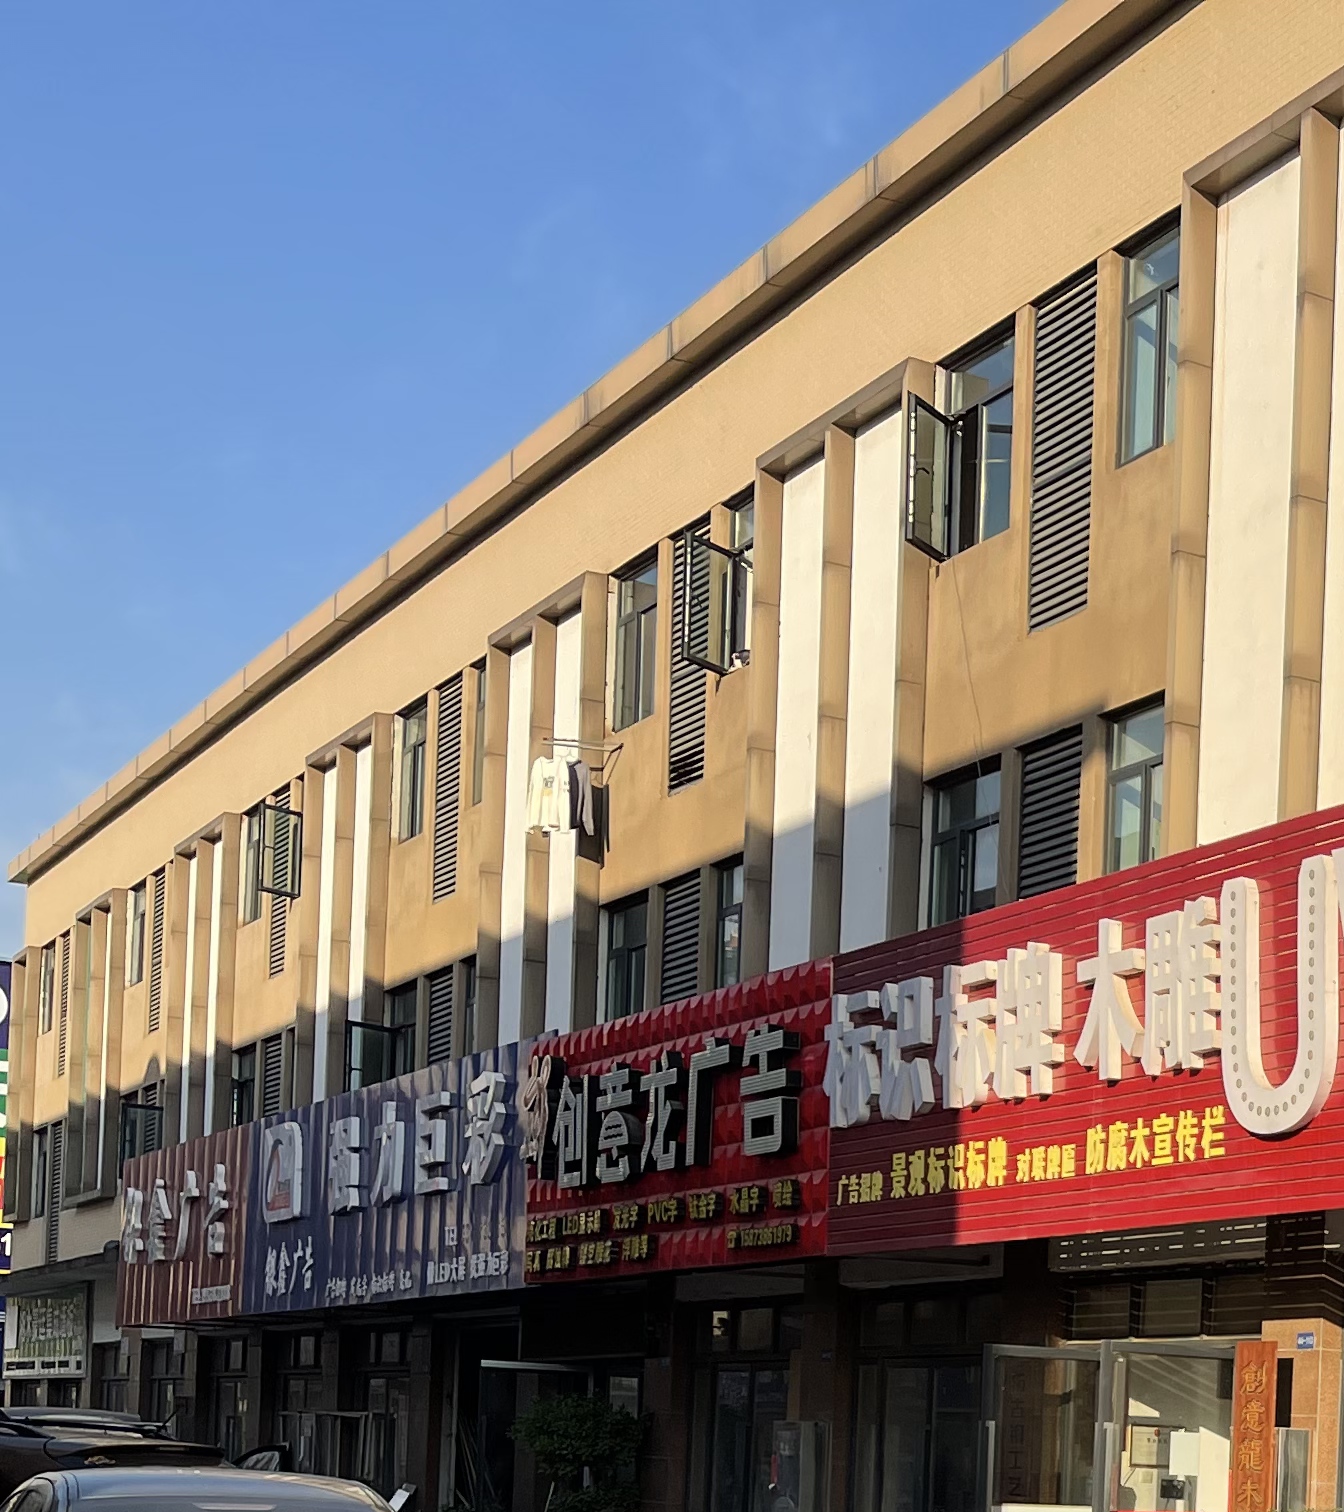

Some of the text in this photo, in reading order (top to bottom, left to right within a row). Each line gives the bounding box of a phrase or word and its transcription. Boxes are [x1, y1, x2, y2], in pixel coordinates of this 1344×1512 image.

[552, 1022, 798, 1189] 创意龙广告
[824, 942, 1063, 1128] 标识标牌
[328, 1071, 506, 1216] 强力巨彩
[837, 1105, 1227, 1206] 广告招牌 景观标识标牌 对联牌匾 防腐木宣传栏
